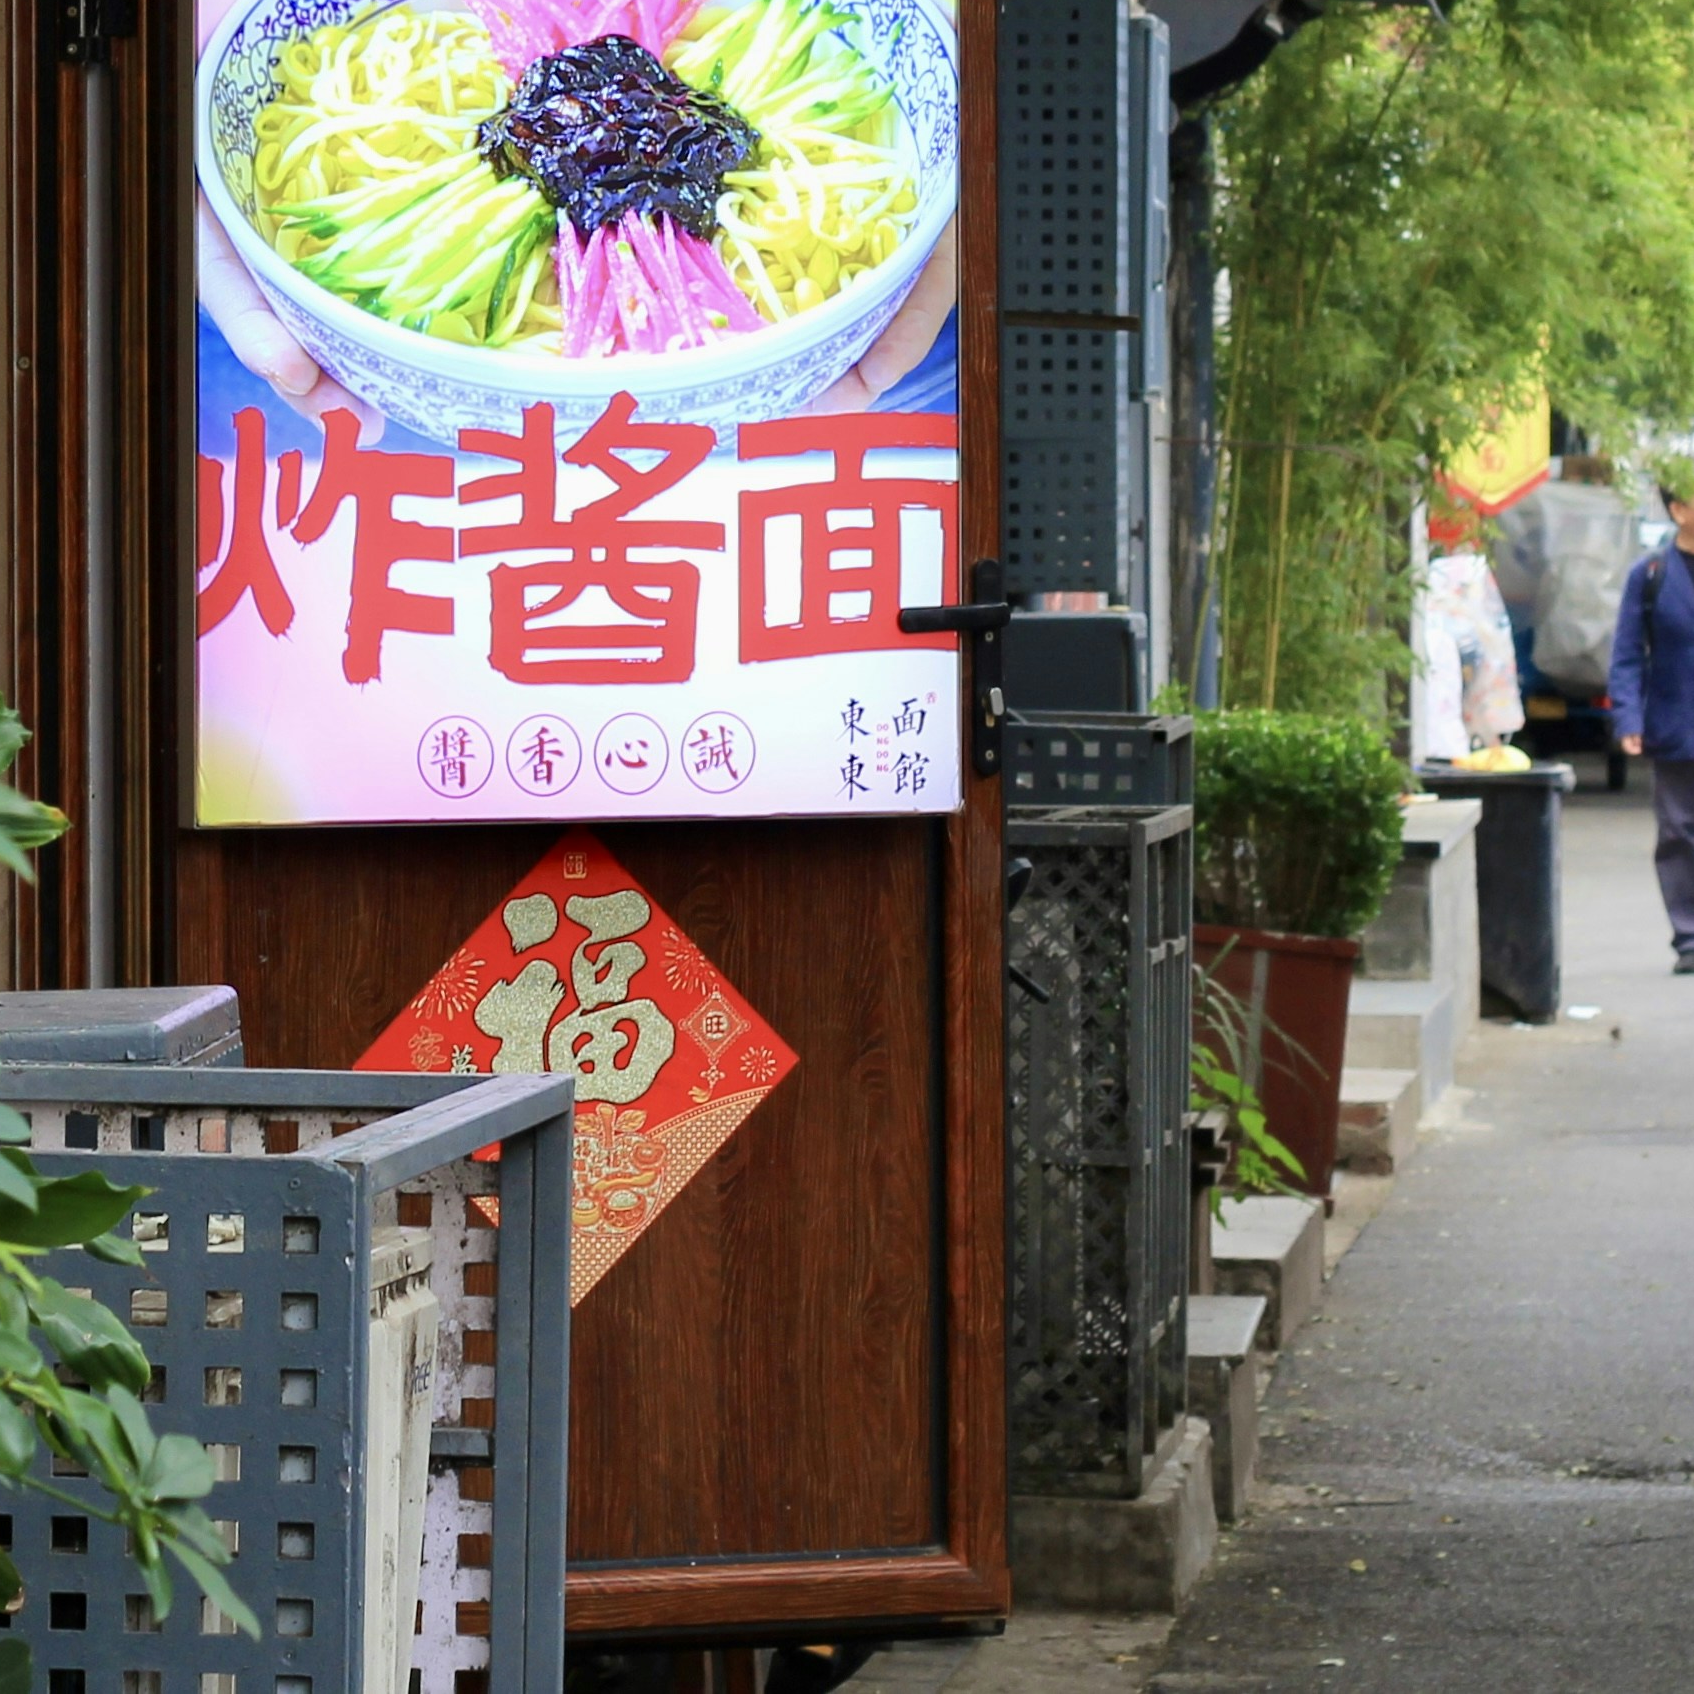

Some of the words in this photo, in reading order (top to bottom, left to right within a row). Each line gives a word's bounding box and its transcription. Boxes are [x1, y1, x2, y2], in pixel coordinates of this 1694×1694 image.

[196, 390, 959, 686] 炸酱面
[472, 888, 676, 1105] 福
